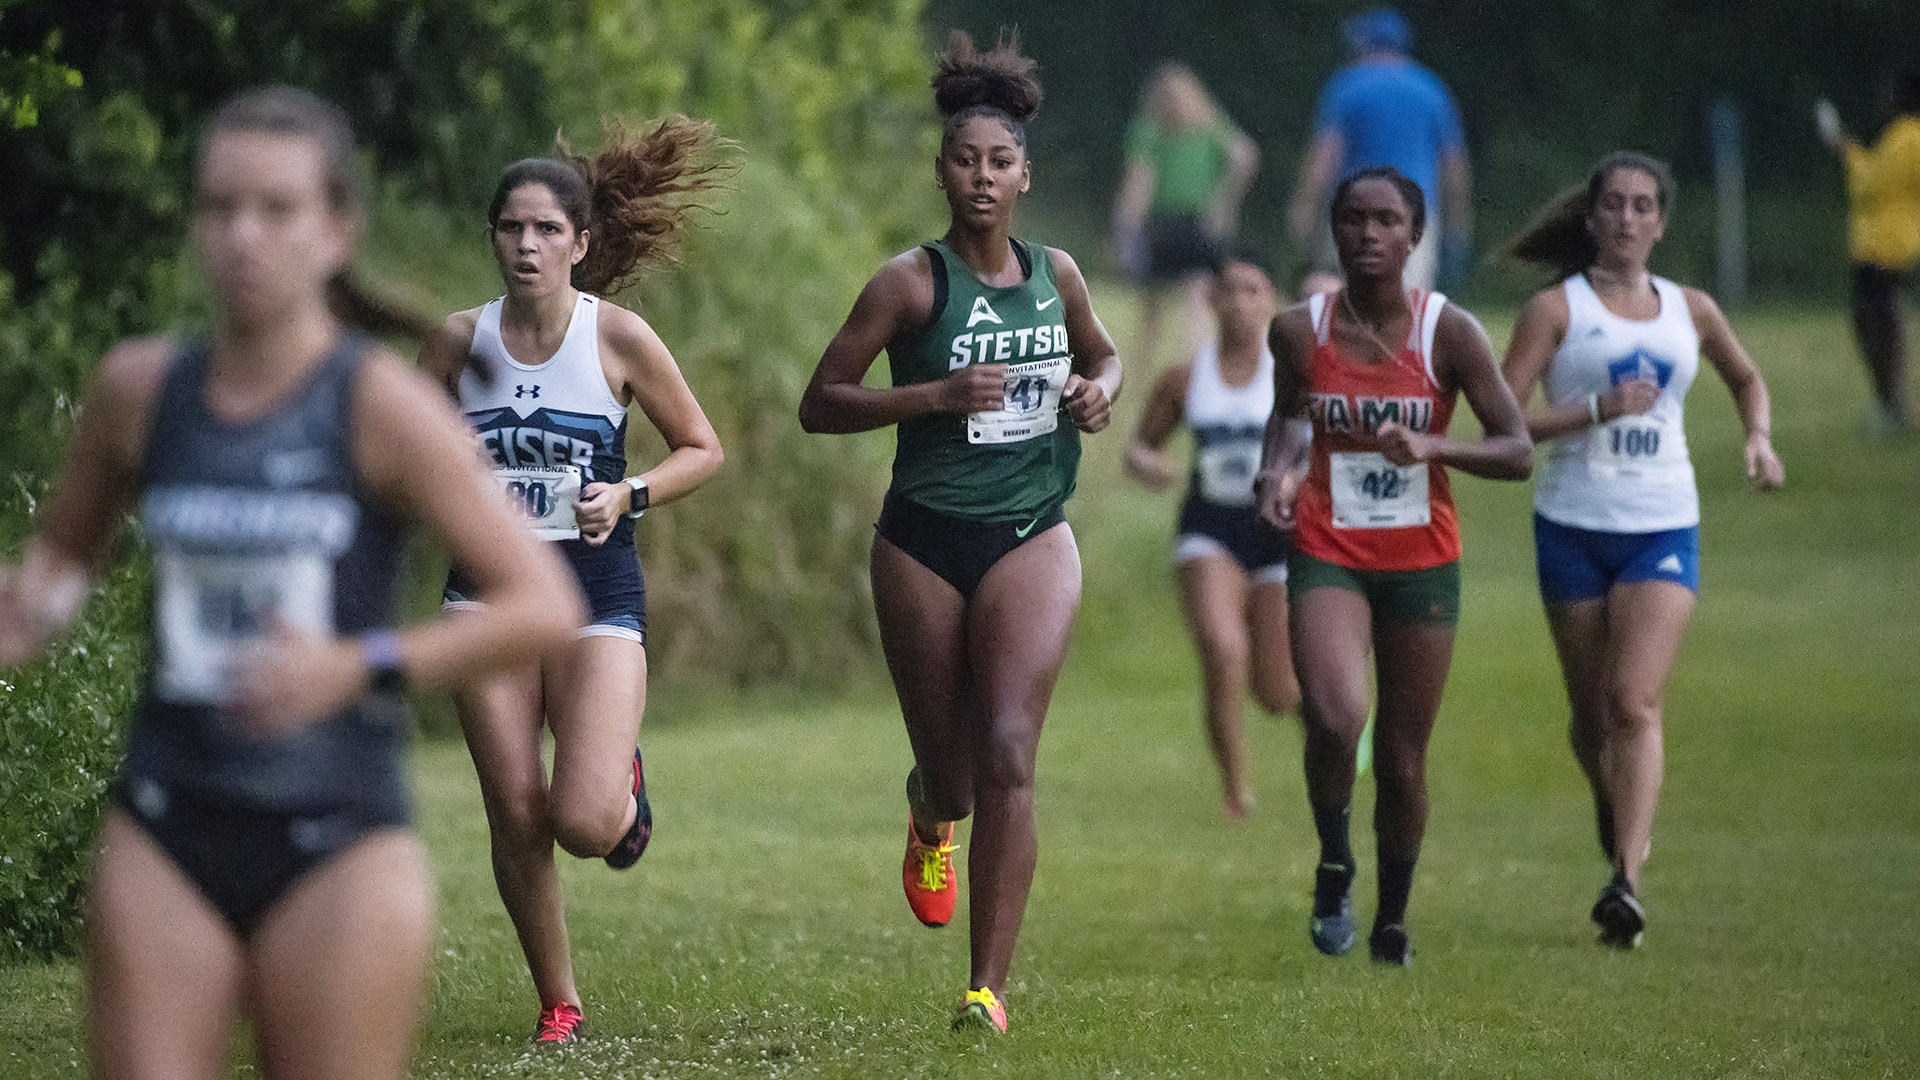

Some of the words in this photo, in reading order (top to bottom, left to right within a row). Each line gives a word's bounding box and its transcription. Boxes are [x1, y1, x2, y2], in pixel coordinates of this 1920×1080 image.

[1005, 360, 1061, 374] INVITATIONAL
[1610, 427, 1661, 457] 100
[1361, 469, 1399, 501] 42
